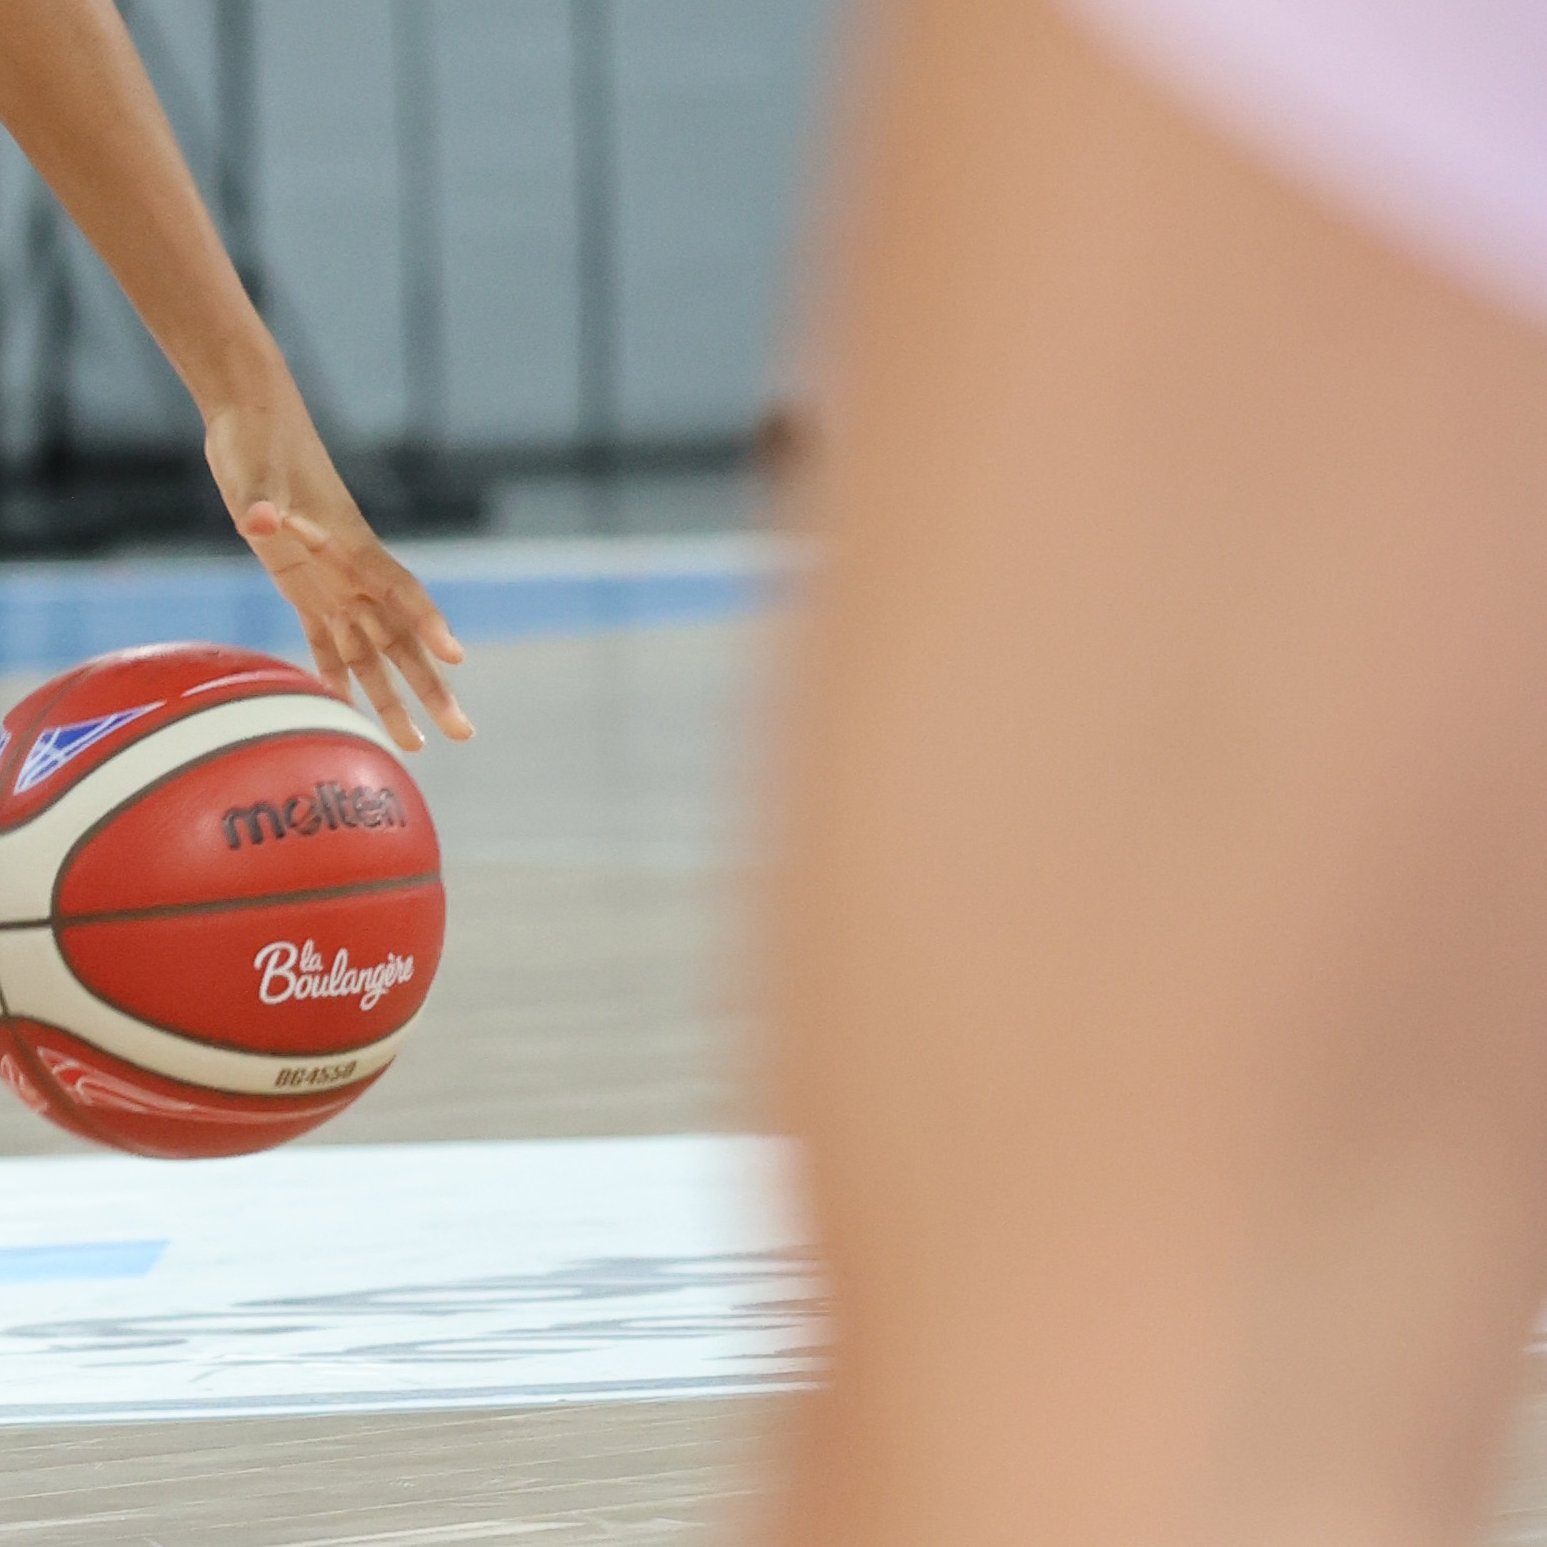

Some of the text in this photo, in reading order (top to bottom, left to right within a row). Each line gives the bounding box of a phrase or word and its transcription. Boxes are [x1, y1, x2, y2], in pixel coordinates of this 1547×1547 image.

[223, 780, 407, 850] molten
[253, 937, 415, 1012] la Boulangère
